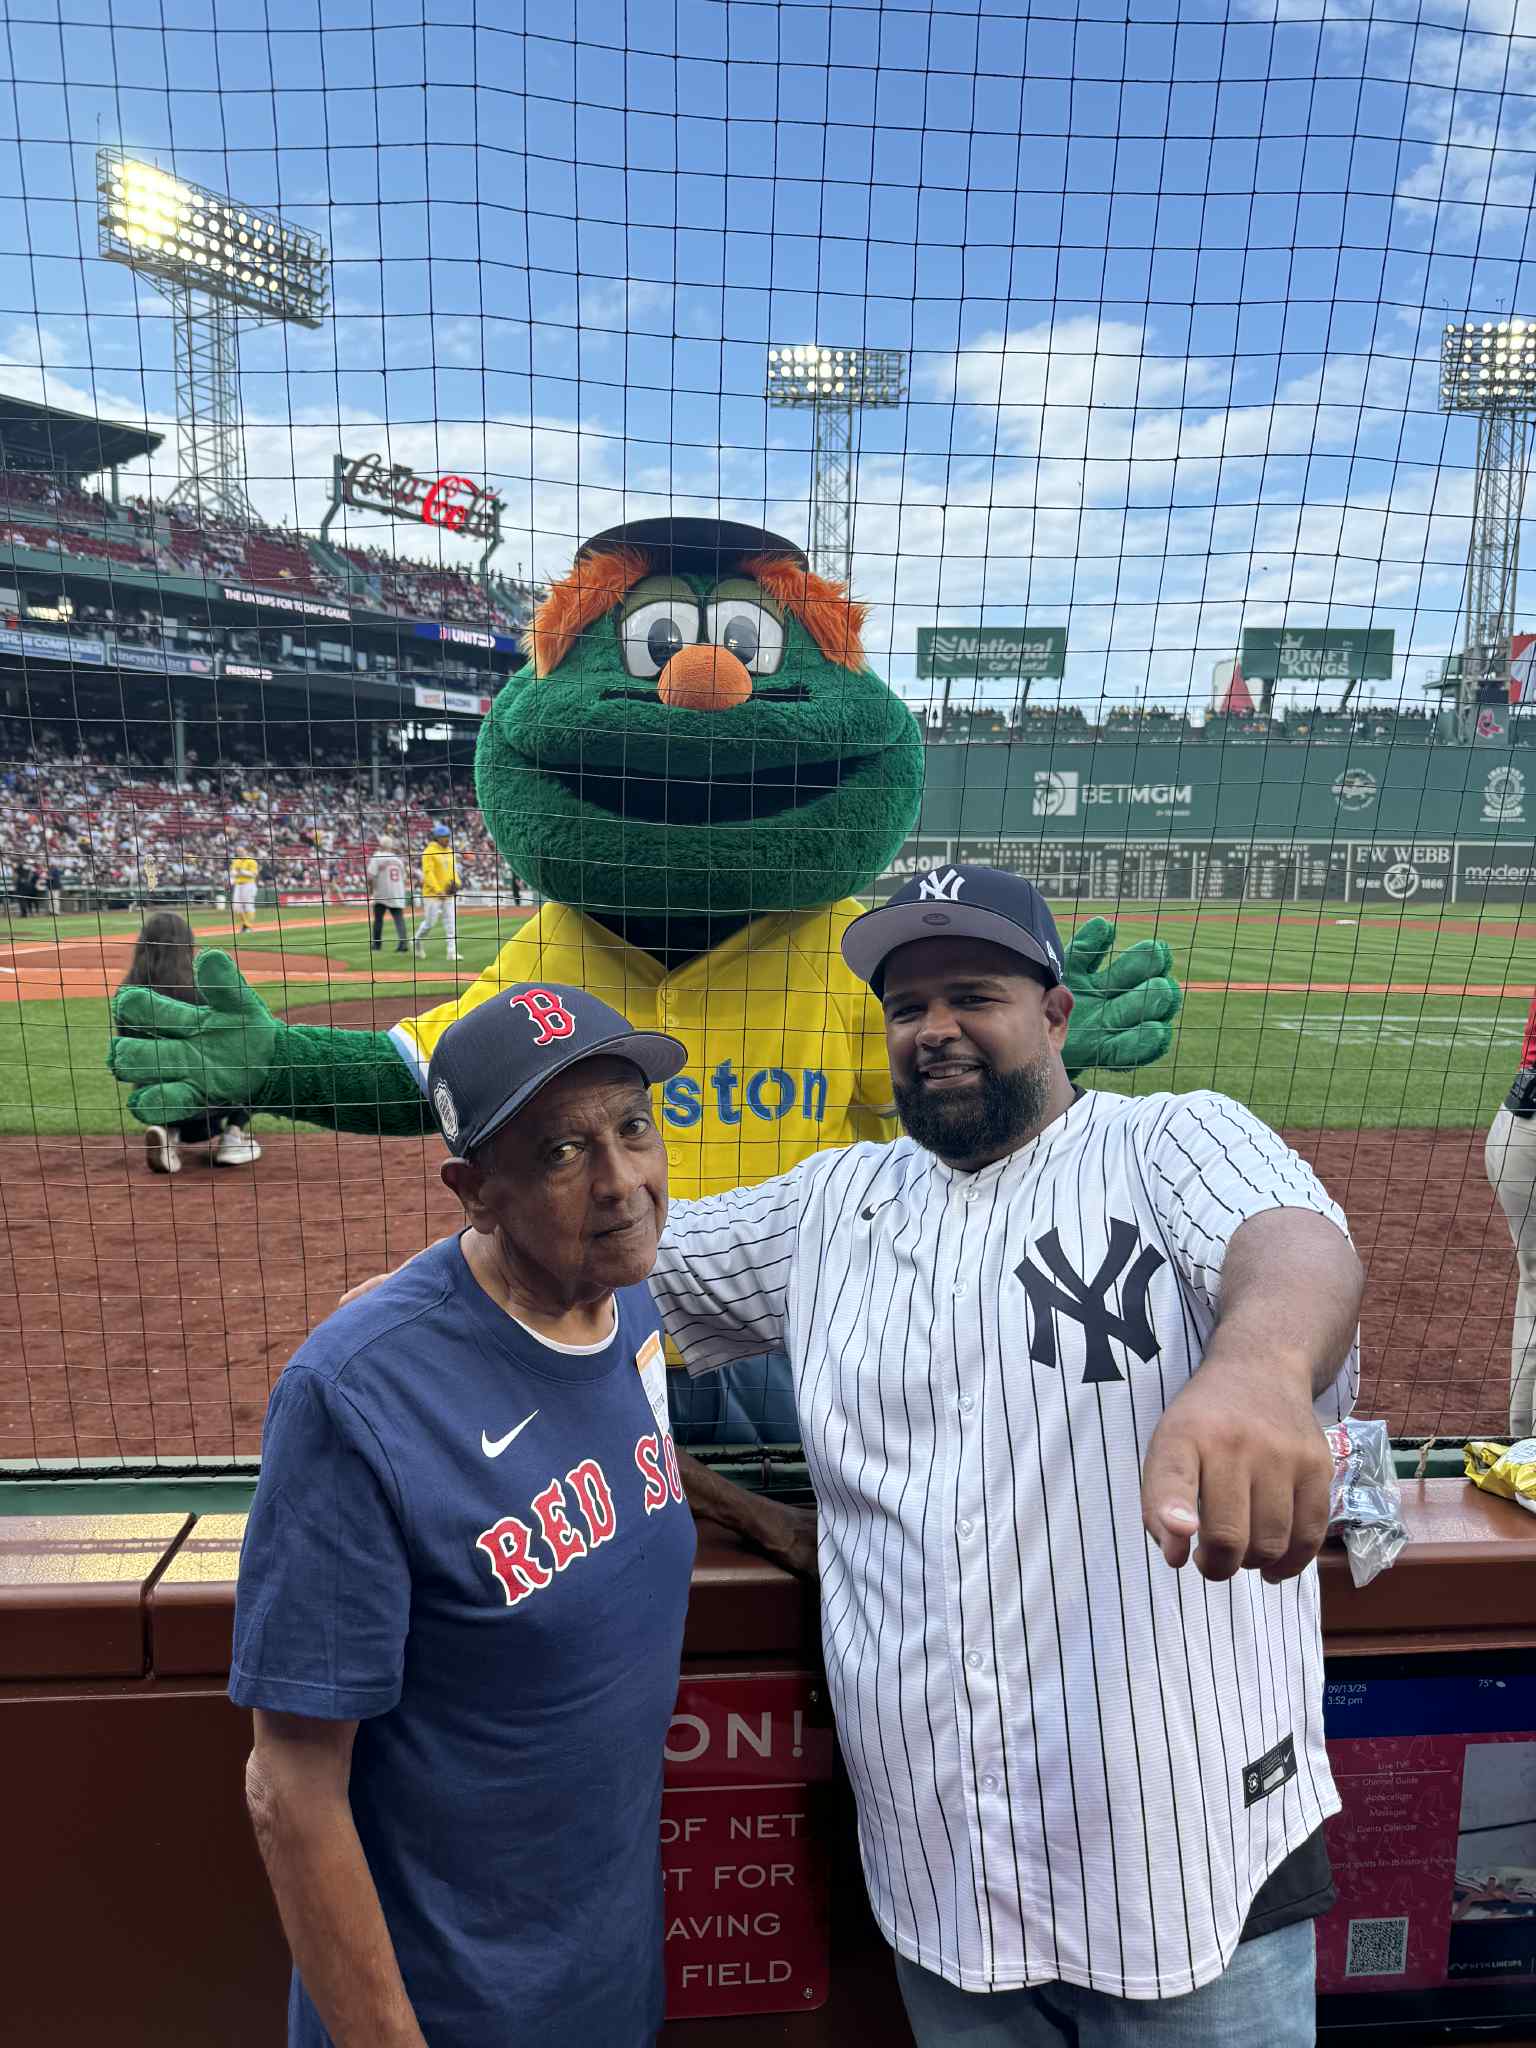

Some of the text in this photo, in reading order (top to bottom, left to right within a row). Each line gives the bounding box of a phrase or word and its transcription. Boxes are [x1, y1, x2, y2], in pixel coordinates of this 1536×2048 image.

[224, 588, 241, 601] THE
[277, 599, 293, 610] FOR
[326, 606, 350, 621] GAME
[452, 628, 496, 649] UNITED
[955, 638, 1053, 659] National
[989, 660, 1048, 671] Car Rental
[1281, 648, 1349, 664] DRAFT
[1287, 660, 1350, 676] KINGS
[1081, 783, 1192, 804] BETMGM
[977, 842, 1064, 850] FENWAY PARK
[1104, 843, 1145, 851] AMERICAN
[1235, 844, 1273, 852] NATIONAL
[1393, 847, 1450, 864] WEBB
[919, 869, 966, 900] NY
[510, 988, 576, 1046] B
[1013, 1216, 1167, 1383] NY
[476, 1459, 616, 1606] RED
[1328, 1684, 1367, 1694] 09/13/25
[1328, 1696, 1363, 1706] 3:52 pm
[1378, 1761, 1394, 1769] Live
[730, 1813, 805, 1839] NET
[714, 1864, 795, 1890] FOR
[682, 1959, 792, 1988] FIELD
